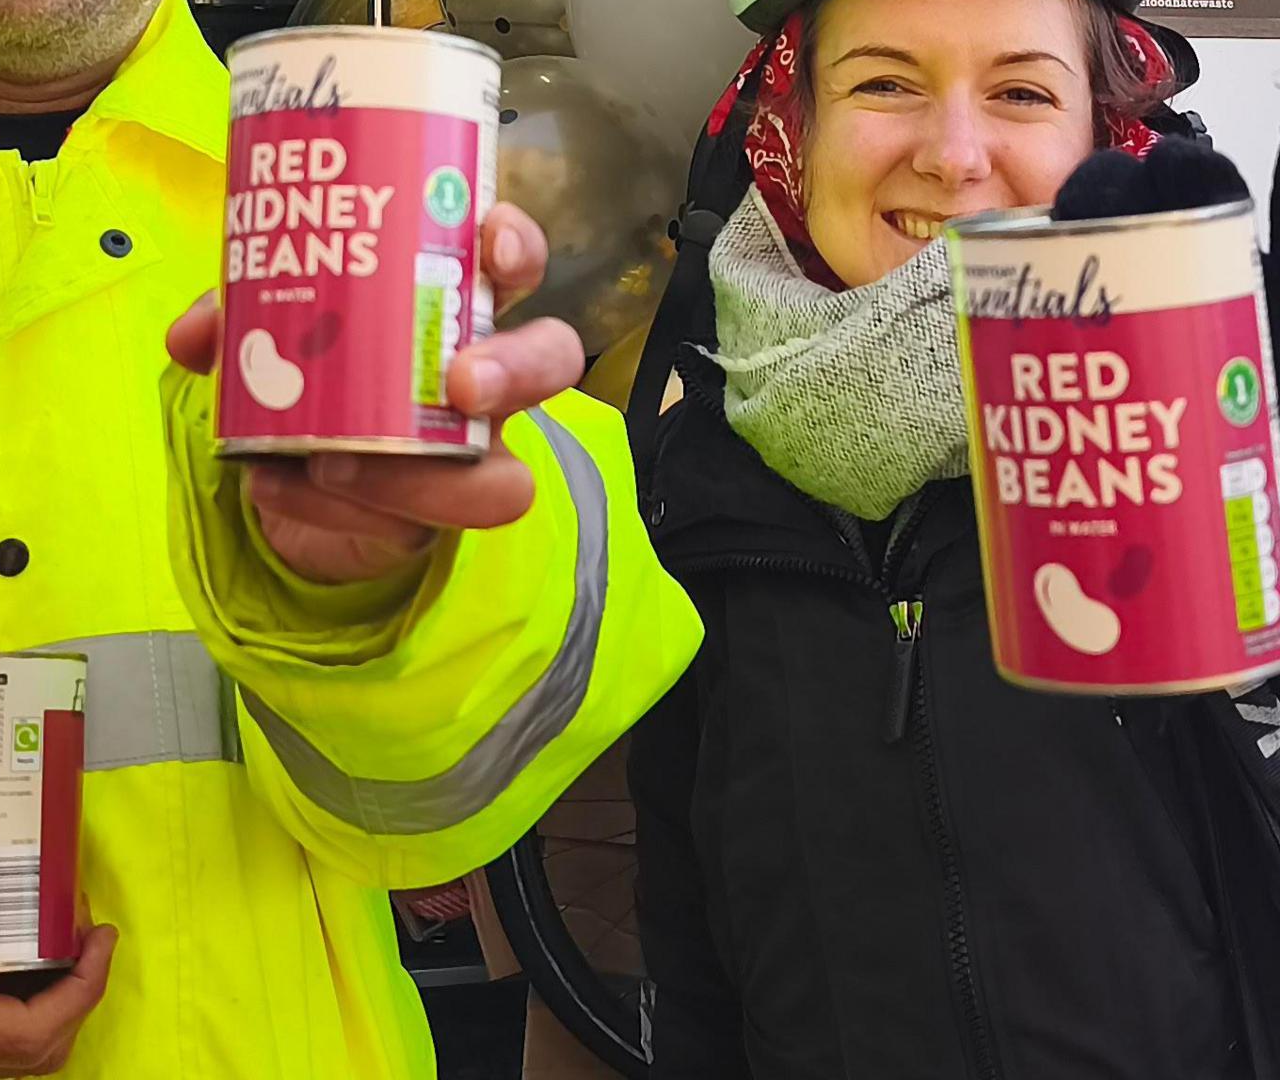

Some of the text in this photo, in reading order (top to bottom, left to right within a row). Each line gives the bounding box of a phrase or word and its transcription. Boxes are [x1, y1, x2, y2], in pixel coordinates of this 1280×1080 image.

[250, 137, 348, 186] RED
[227, 184, 396, 233] KIDNEY
[227, 232, 380, 283] BEANS
[1010, 350, 1130, 402] RED
[984, 397, 1188, 456] KIDNEY
[995, 454, 1184, 509] BEANS
